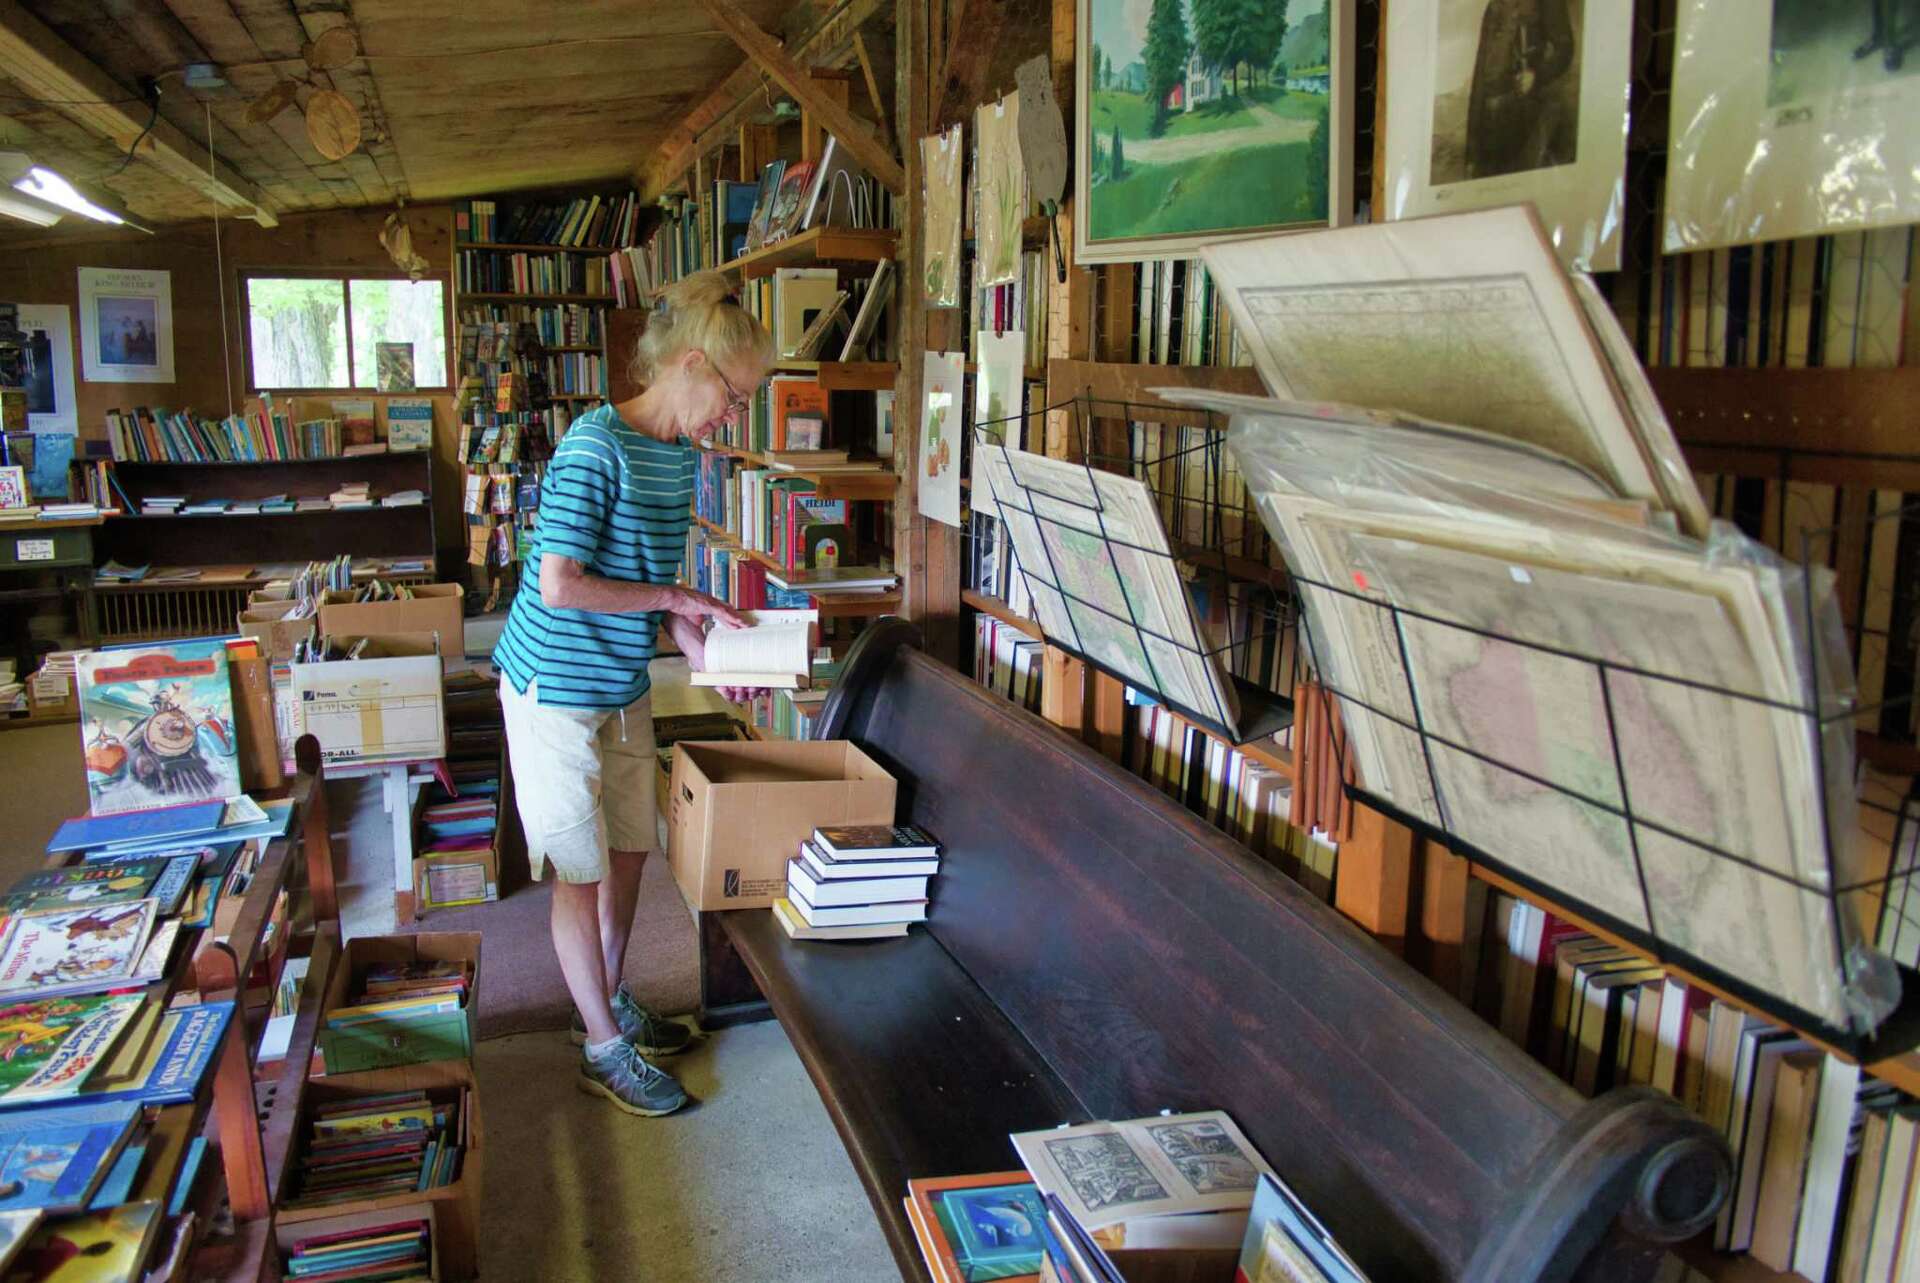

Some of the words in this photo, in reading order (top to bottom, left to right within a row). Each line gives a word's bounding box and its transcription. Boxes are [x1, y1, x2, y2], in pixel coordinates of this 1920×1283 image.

[805, 498, 836, 508] HEIDI
[320, 749, 359, 758] OR-ALL
[19, 930, 41, 951] The
[2, 950, 29, 981] Mitten
[172, 1010, 210, 1056] RAGGEDY
[157, 1055, 188, 1086] ANDY
